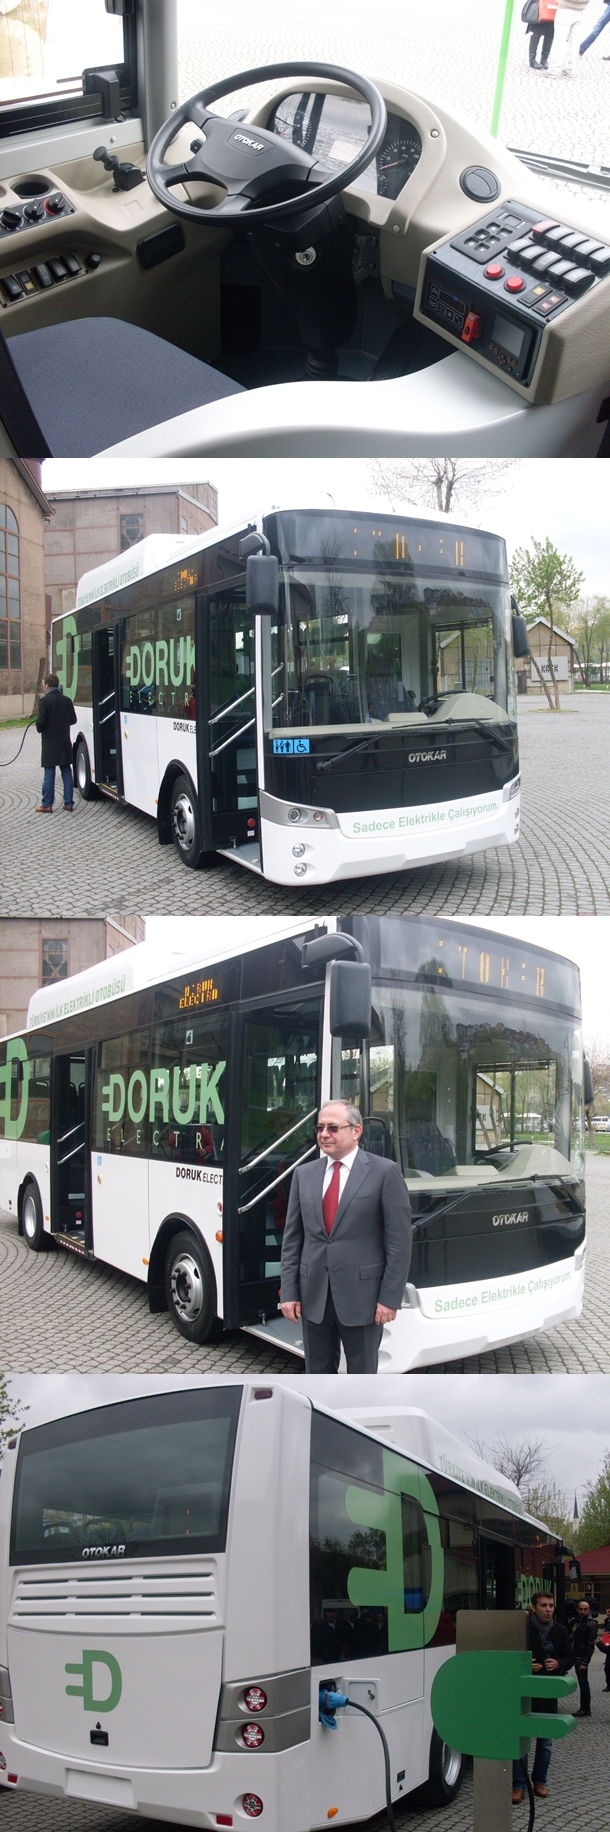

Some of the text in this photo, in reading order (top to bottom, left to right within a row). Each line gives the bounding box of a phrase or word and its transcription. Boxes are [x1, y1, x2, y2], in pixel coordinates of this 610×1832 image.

[234, 134, 264, 151] OTOKAR
[126, 635, 196, 687] DORUK
[173, 721, 189, 733] DORUK
[408, 750, 448, 763] OTOKAR
[353, 802, 500, 834] Sadece Elektrikle Çalışıyorum.
[95, 974, 126, 1003] OTOBÜSÜ
[102, 1061, 226, 1125] DORUK
[106, 1127, 224, 1151] ELECTR
[176, 1167, 202, 1182] DORUK
[492, 1211, 529, 1227] OTOKAR
[434, 1271, 573, 1313] Sadece Elektrikle Çalışıyorum.
[82, 1544, 126, 1558] OTOKAR
